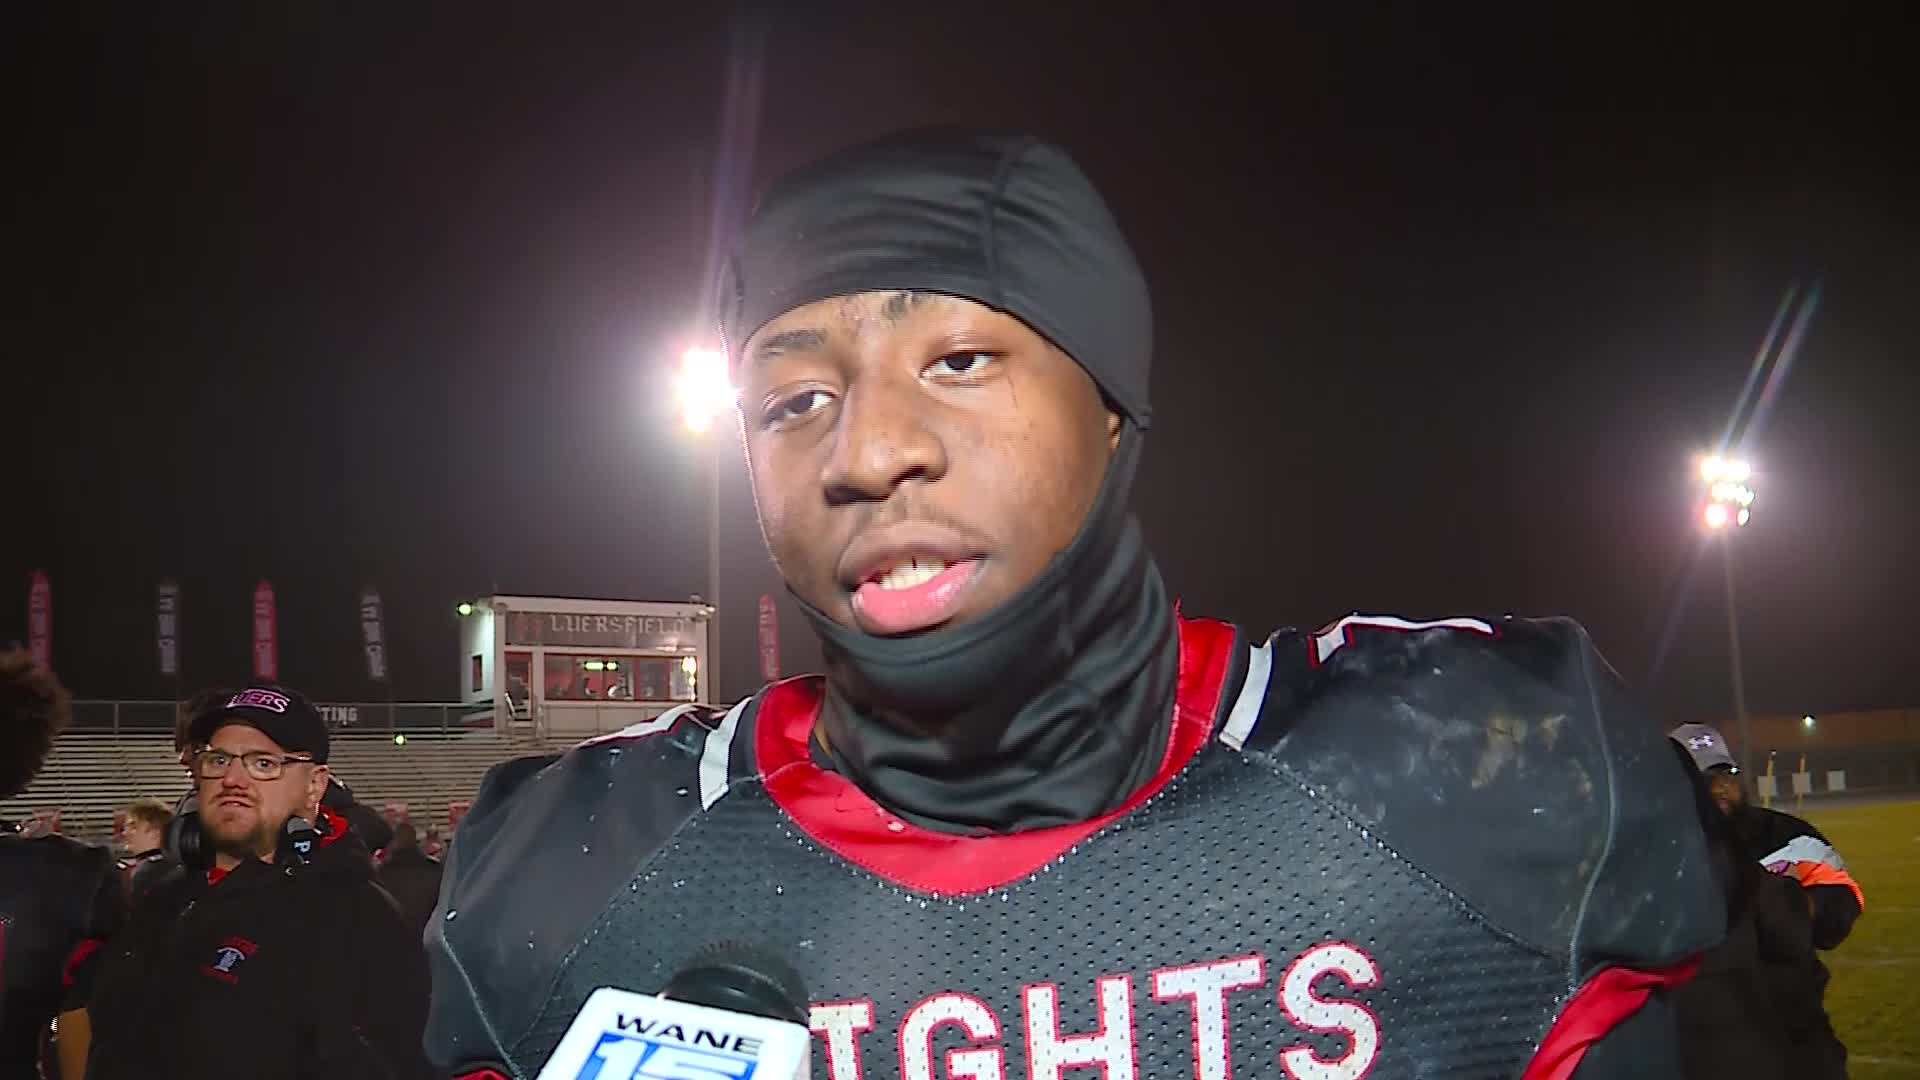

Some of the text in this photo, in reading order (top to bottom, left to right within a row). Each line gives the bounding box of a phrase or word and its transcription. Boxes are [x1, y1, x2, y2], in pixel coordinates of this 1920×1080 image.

[315, 706, 358, 722] TING
[808, 941, 1383, 1080] IGHTS
[616, 1013, 764, 1056] WANE
